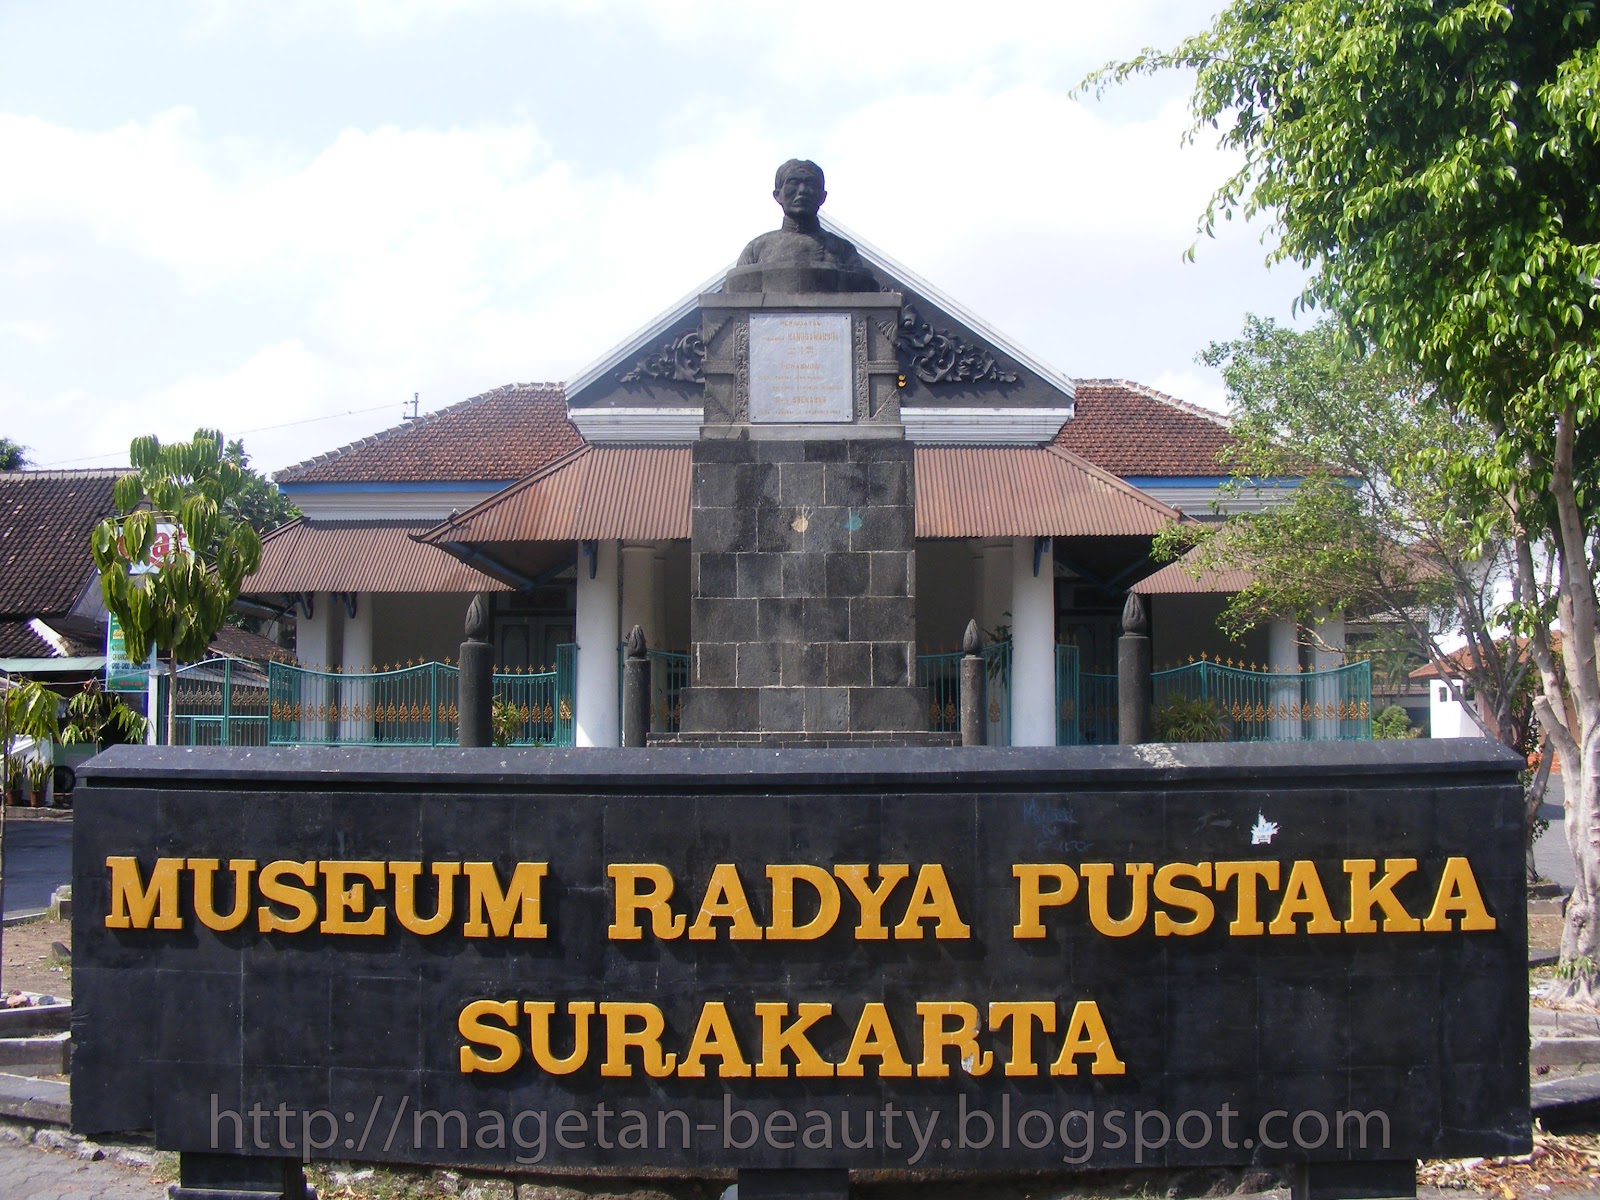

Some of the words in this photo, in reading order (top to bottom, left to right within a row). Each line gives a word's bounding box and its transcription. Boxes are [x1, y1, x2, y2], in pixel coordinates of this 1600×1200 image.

[106, 857, 549, 940] MUSEUM
[607, 863, 971, 942] RADYA
[1012, 856, 1496, 940] PUSTAKA
[457, 999, 1126, 1079] SURAKARTA
